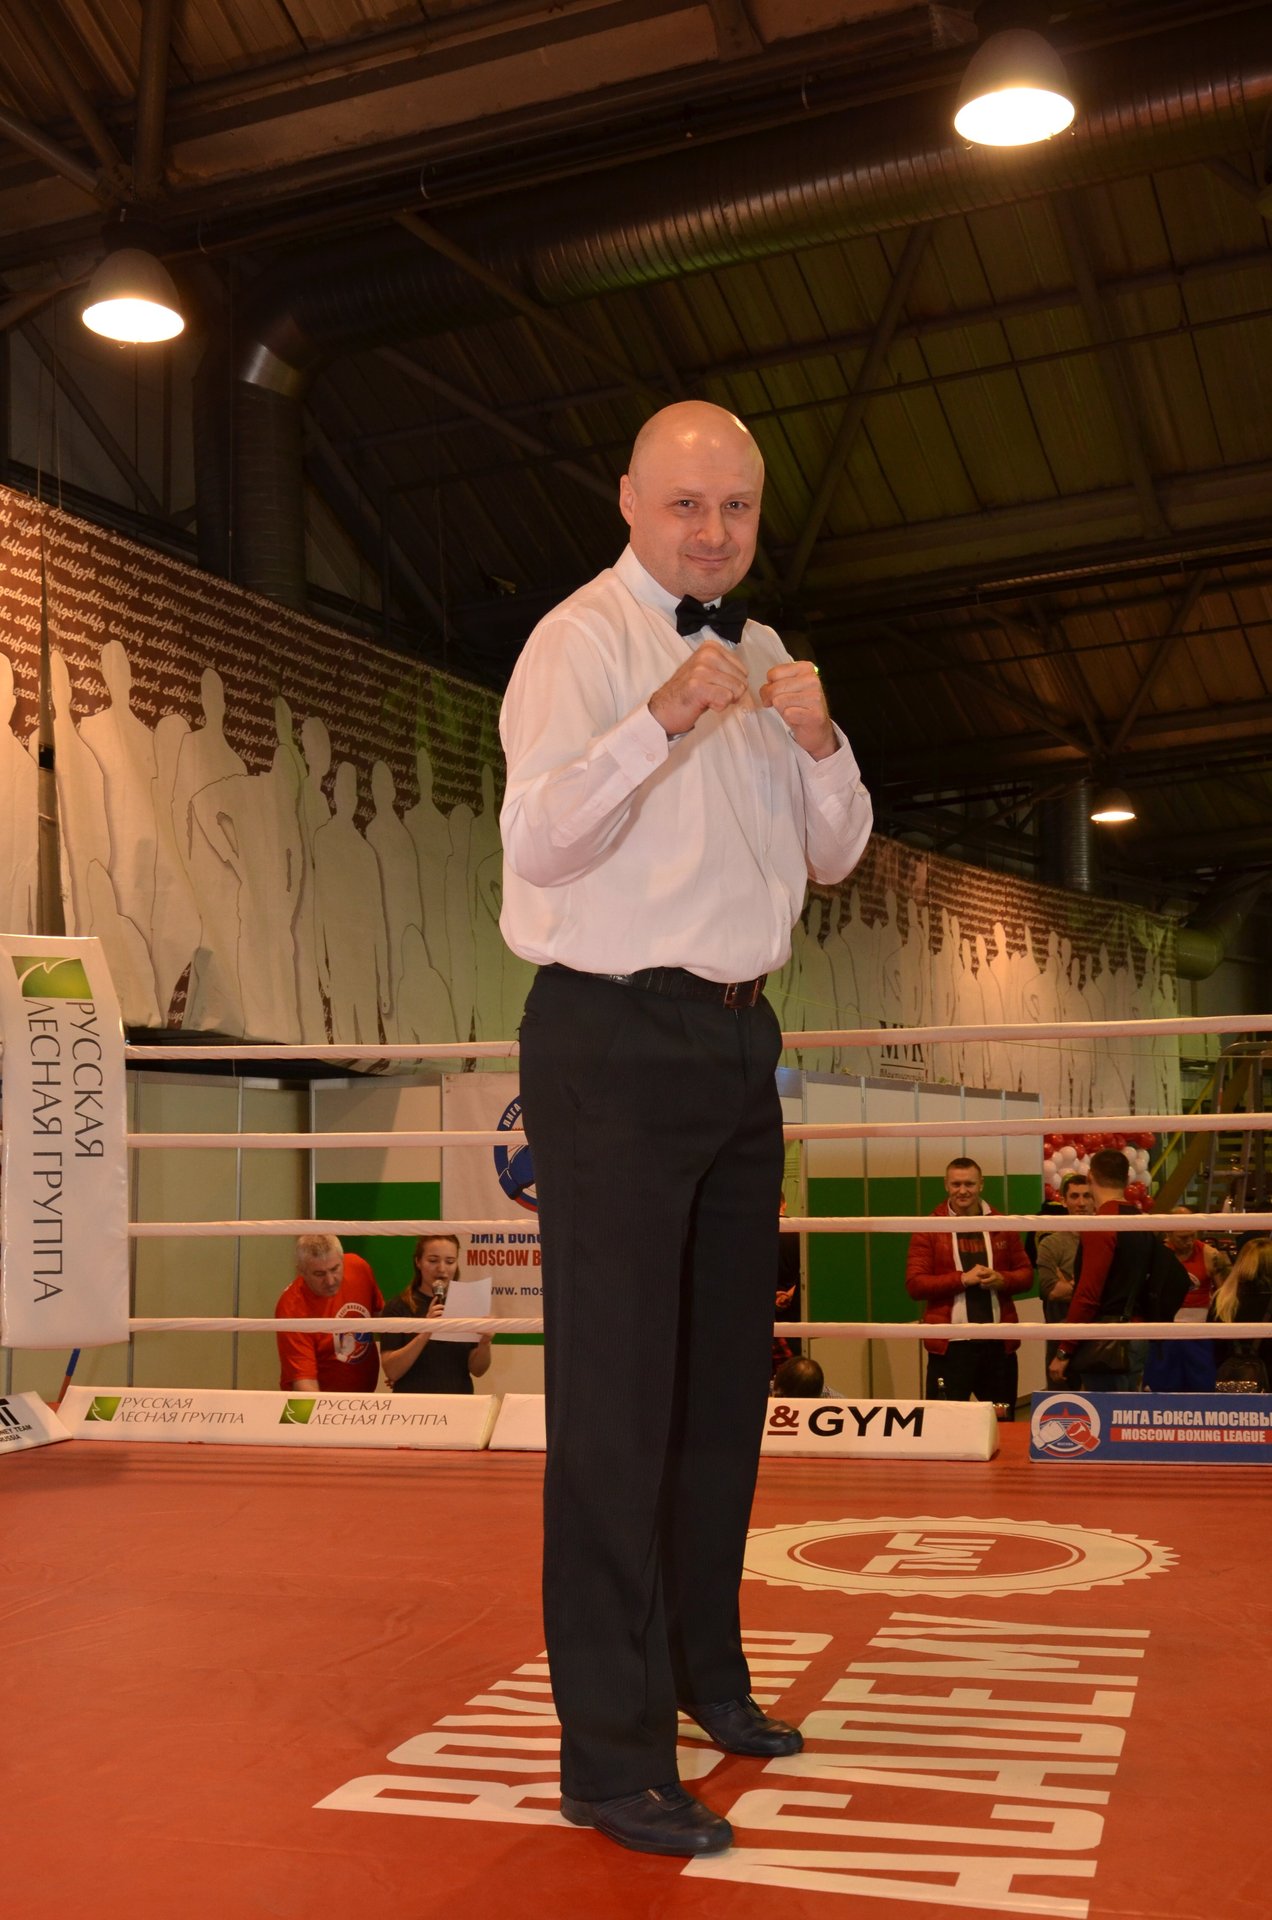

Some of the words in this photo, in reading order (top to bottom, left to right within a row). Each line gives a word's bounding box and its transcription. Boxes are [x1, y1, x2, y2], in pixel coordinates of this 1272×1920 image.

[23, 999, 63, 1136] ЛЕСНАЯ
[65, 1001, 105, 1158] РУССКАЯ
[32, 1151, 64, 1303] ГРУППА
[467, 1250, 529, 1266] MOSCOW
[121, 1397, 194, 1409] РУССКАЯ
[316, 1400, 392, 1411] РУССКАЯ
[114, 1411, 178, 1422] ЛЕСНАЯ
[180, 1412, 245, 1424] ГРУППА
[310, 1413, 378, 1425] ЛЕСНАЯ
[381, 1414, 449, 1426] ГРУППА
[808, 1405, 925, 1437] GYM
[1112, 1410, 1149, 1425] ЛИГА
[1152, 1410, 1204, 1426] БОКСА
[1121, 1428, 1177, 1441] MOSCOW
[1177, 1430, 1220, 1442] BOXING
[1223, 1430, 1266, 1442] LEAGUE
[681, 1611, 1151, 1919] ACADEMY
